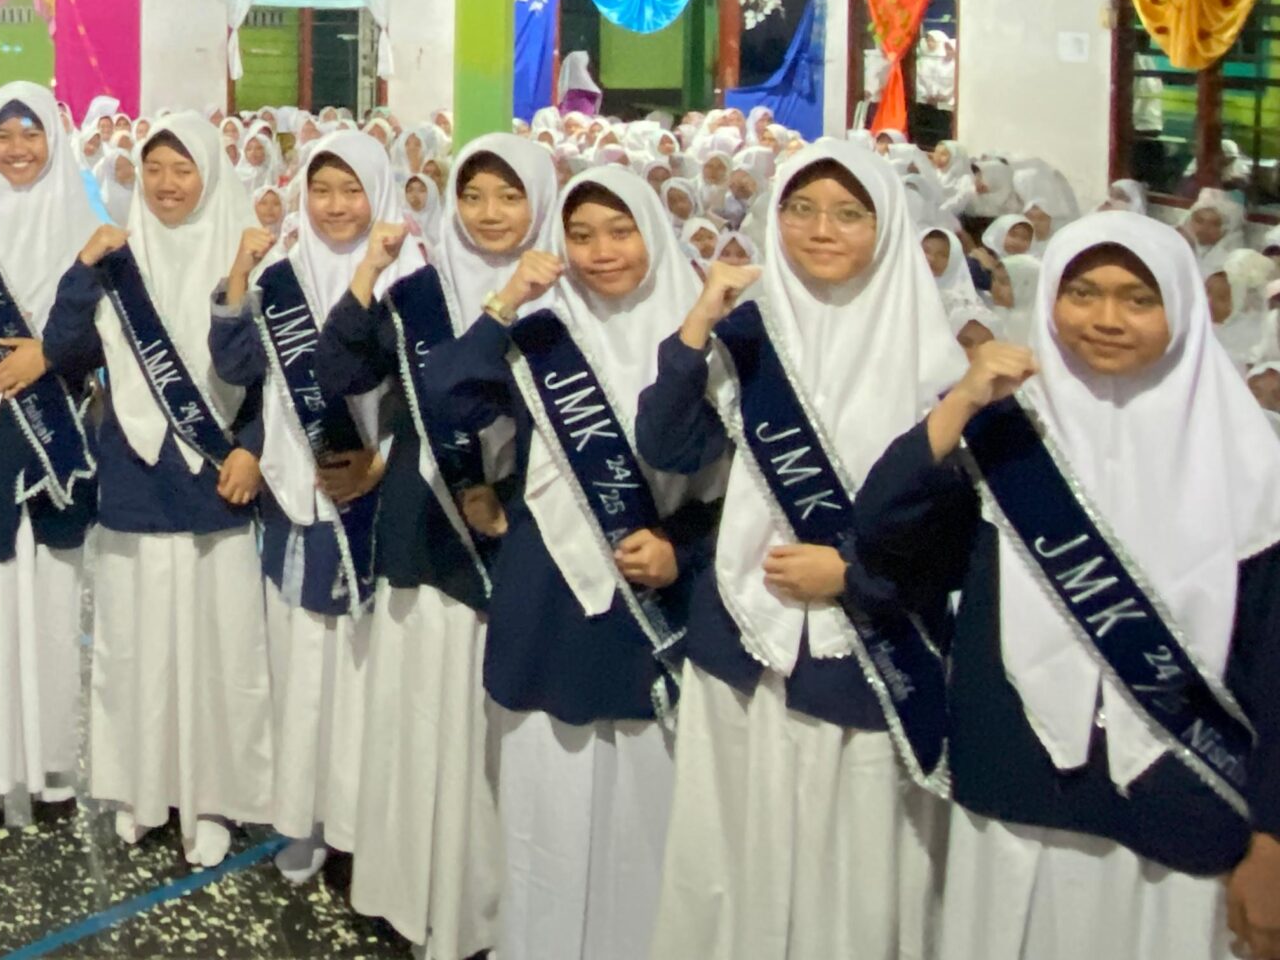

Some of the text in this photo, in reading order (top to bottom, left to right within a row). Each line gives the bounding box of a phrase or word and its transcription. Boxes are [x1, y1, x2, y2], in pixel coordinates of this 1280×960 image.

[139, 339, 182, 395] JMK
[265, 303, 320, 367] JMK
[544, 370, 642, 516] JMK 24/25
[756, 421, 843, 520] JMK
[1034, 533, 1147, 638] JMK
